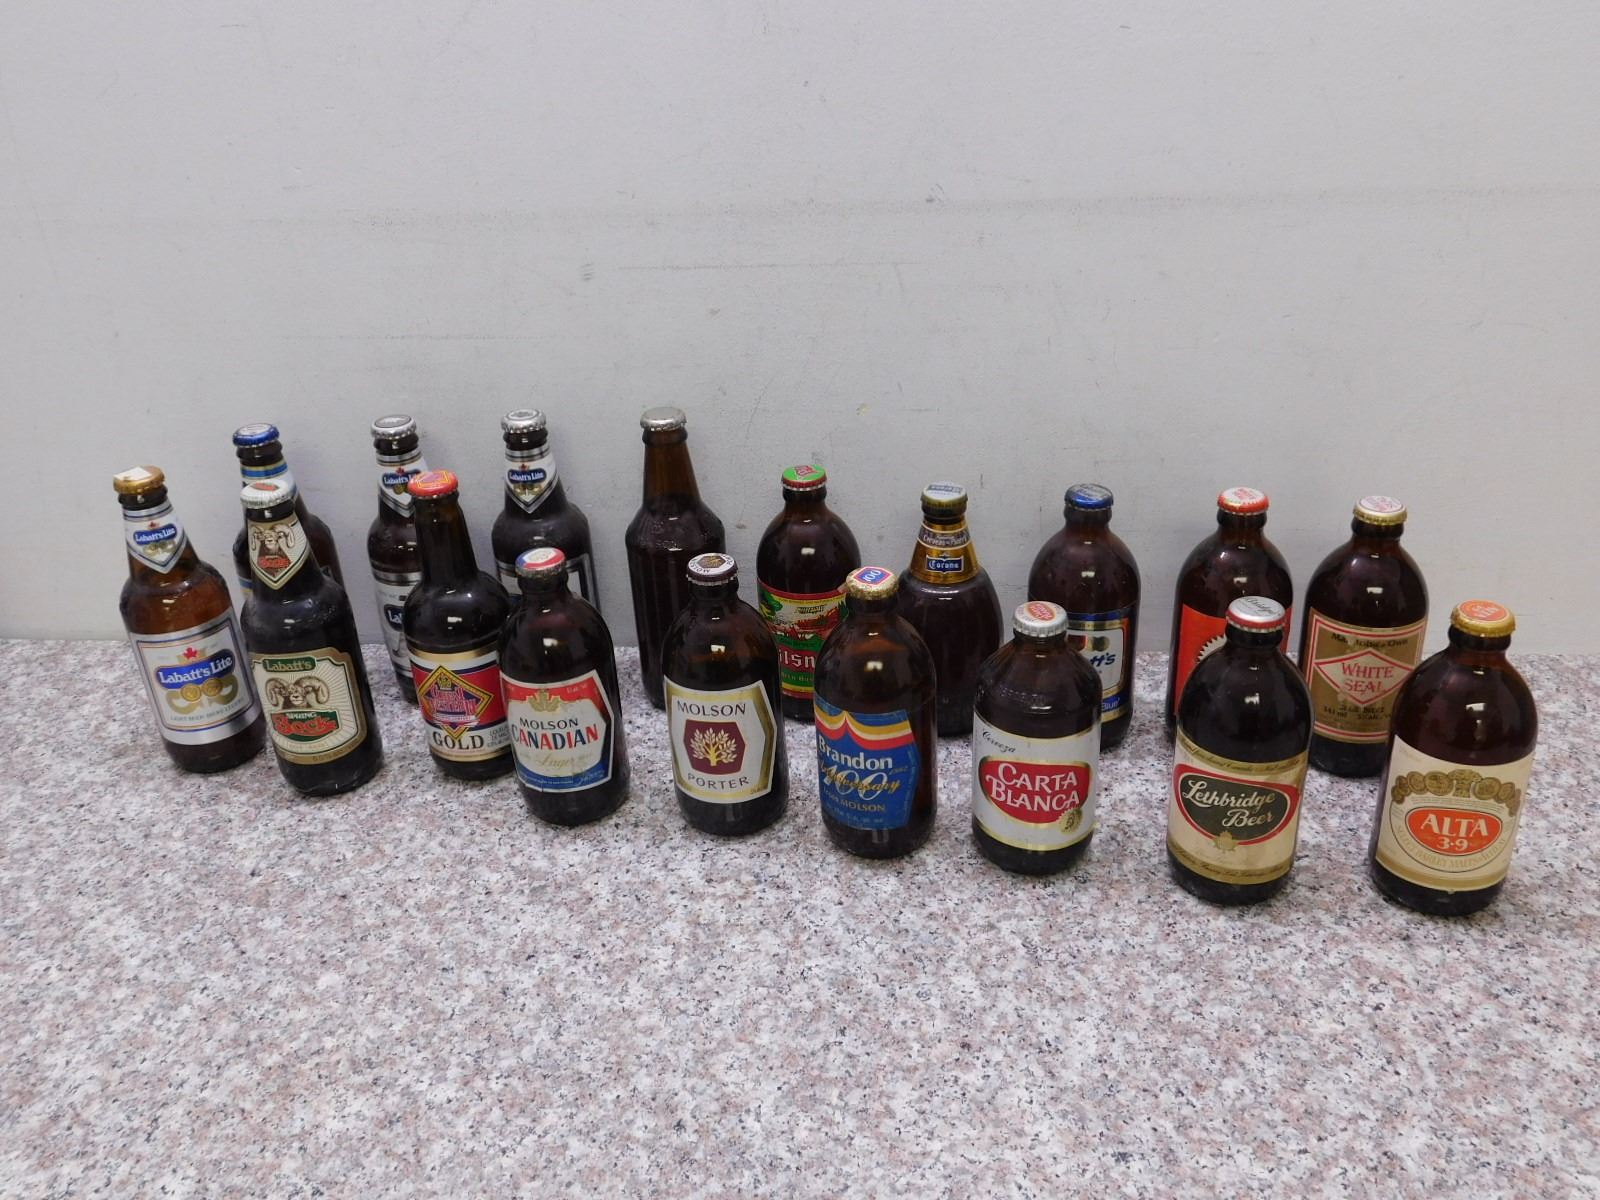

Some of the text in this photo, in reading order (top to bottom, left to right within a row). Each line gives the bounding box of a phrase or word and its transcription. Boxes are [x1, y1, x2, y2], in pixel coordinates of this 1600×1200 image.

[265, 659, 313, 671] Labatt's
[779, 648, 816, 668] ilsn
[157, 656, 234, 684] Labatt's Lite
[1341, 662, 1395, 679] WHITE
[1344, 678, 1387, 693] SEAL
[677, 700, 746, 717] MOLSON
[271, 714, 338, 737] Bock
[519, 717, 579, 730] MOLSON
[433, 731, 485, 750] GOLD
[511, 723, 599, 750] CANADIAN
[818, 734, 893, 771] Brandon
[688, 772, 750, 789] PORTER
[998, 762, 1078, 793] CARTA
[985, 774, 1080, 812] BLANCA
[1182, 780, 1276, 813] Lethbridge
[1221, 808, 1274, 827] Beer
[1420, 813, 1489, 838] ALTA
